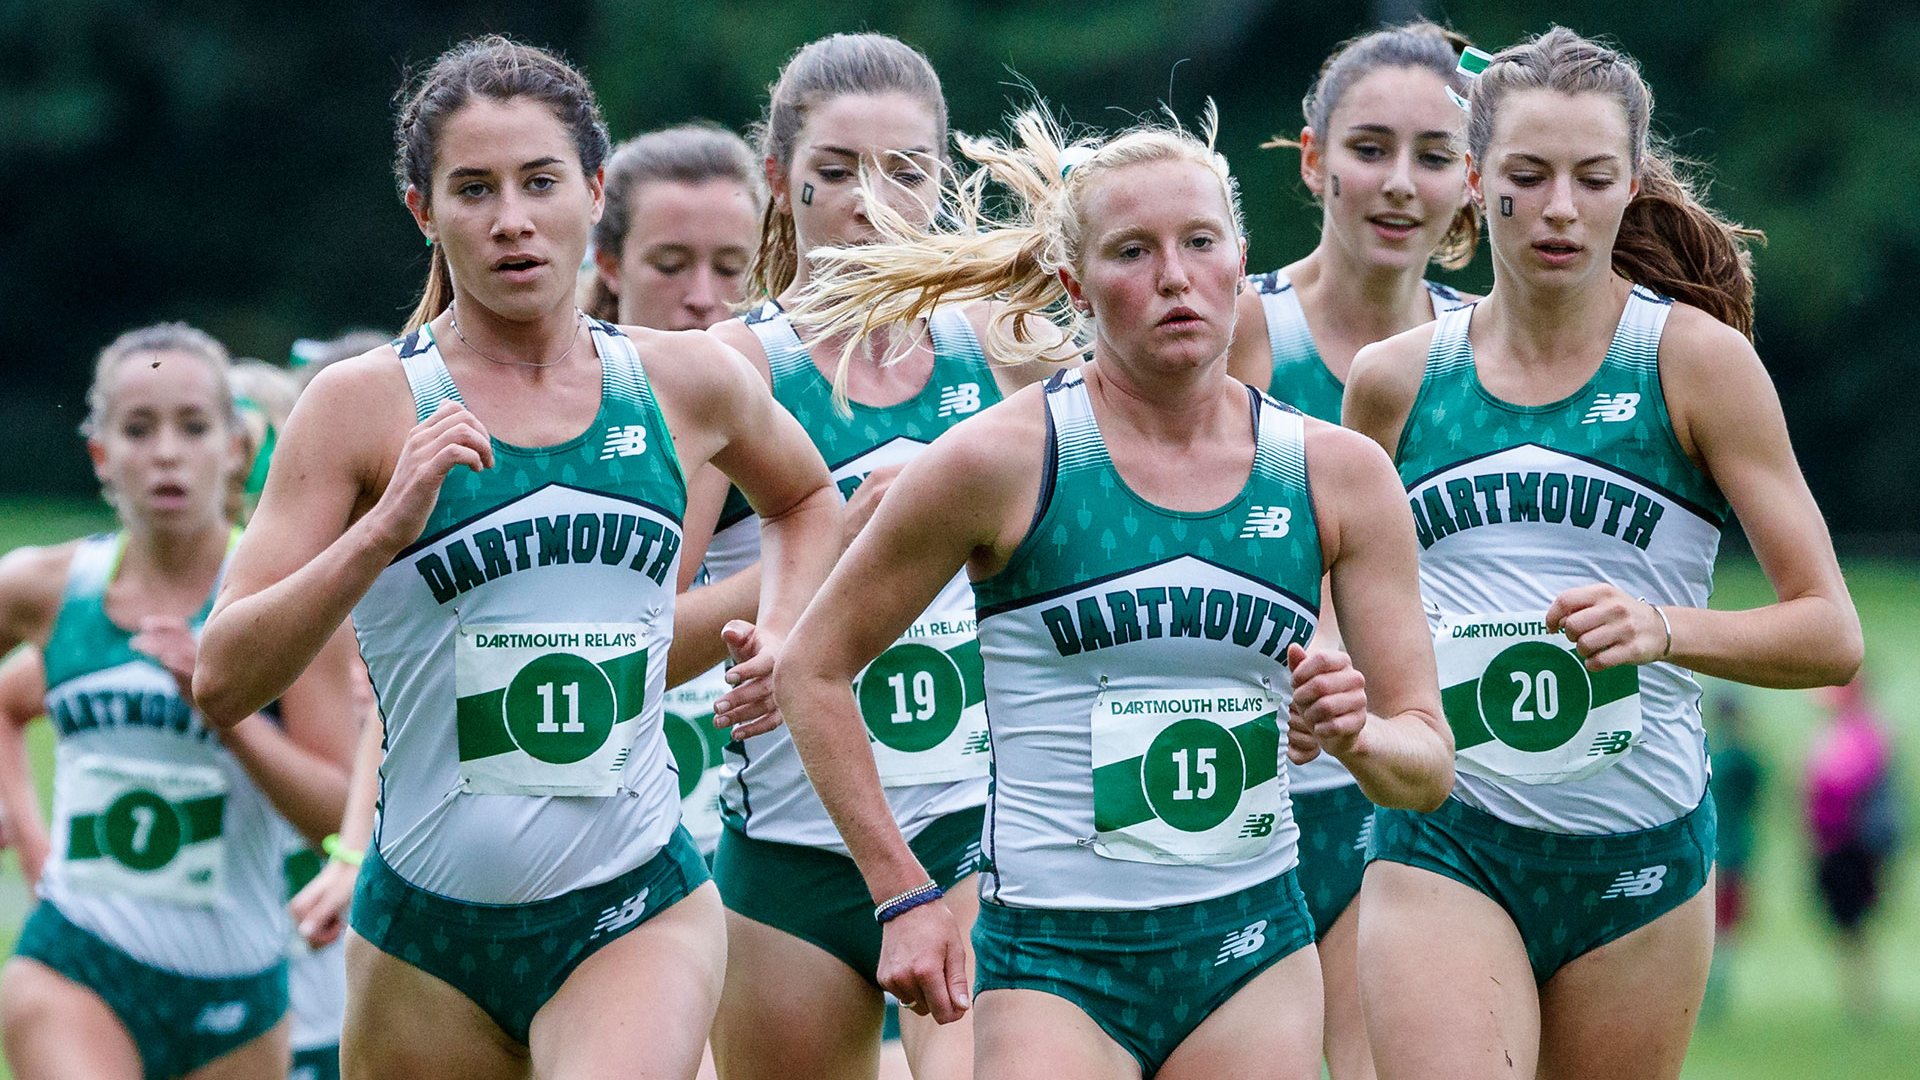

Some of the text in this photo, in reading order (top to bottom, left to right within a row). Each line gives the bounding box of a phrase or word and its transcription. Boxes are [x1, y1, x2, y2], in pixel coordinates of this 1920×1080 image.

[938, 383, 981, 418] NB
[1582, 392, 1642, 425] NB
[600, 425, 648, 460] NB
[1239, 505, 1292, 539] NB
[1410, 472, 1665, 551] DARTMOUTH
[415, 512, 683, 606] DARTMOUTH
[475, 632, 638, 650] DARTMOUTH RELAYS
[1040, 586, 1315, 668] DARTMOUTH
[1452, 621, 1549, 639] DARTMOUTH
[536, 681, 585, 734] 11
[888, 670, 936, 724] 19
[1111, 697, 1264, 716] DARTMOUTH RELAYS
[1510, 669, 1560, 722] 20
[1587, 730, 1633, 757] NB
[1172, 748, 1218, 801] 15
[1238, 813, 1276, 839] NB
[1601, 864, 1668, 900] NB
[1214, 919, 1269, 967] NB
